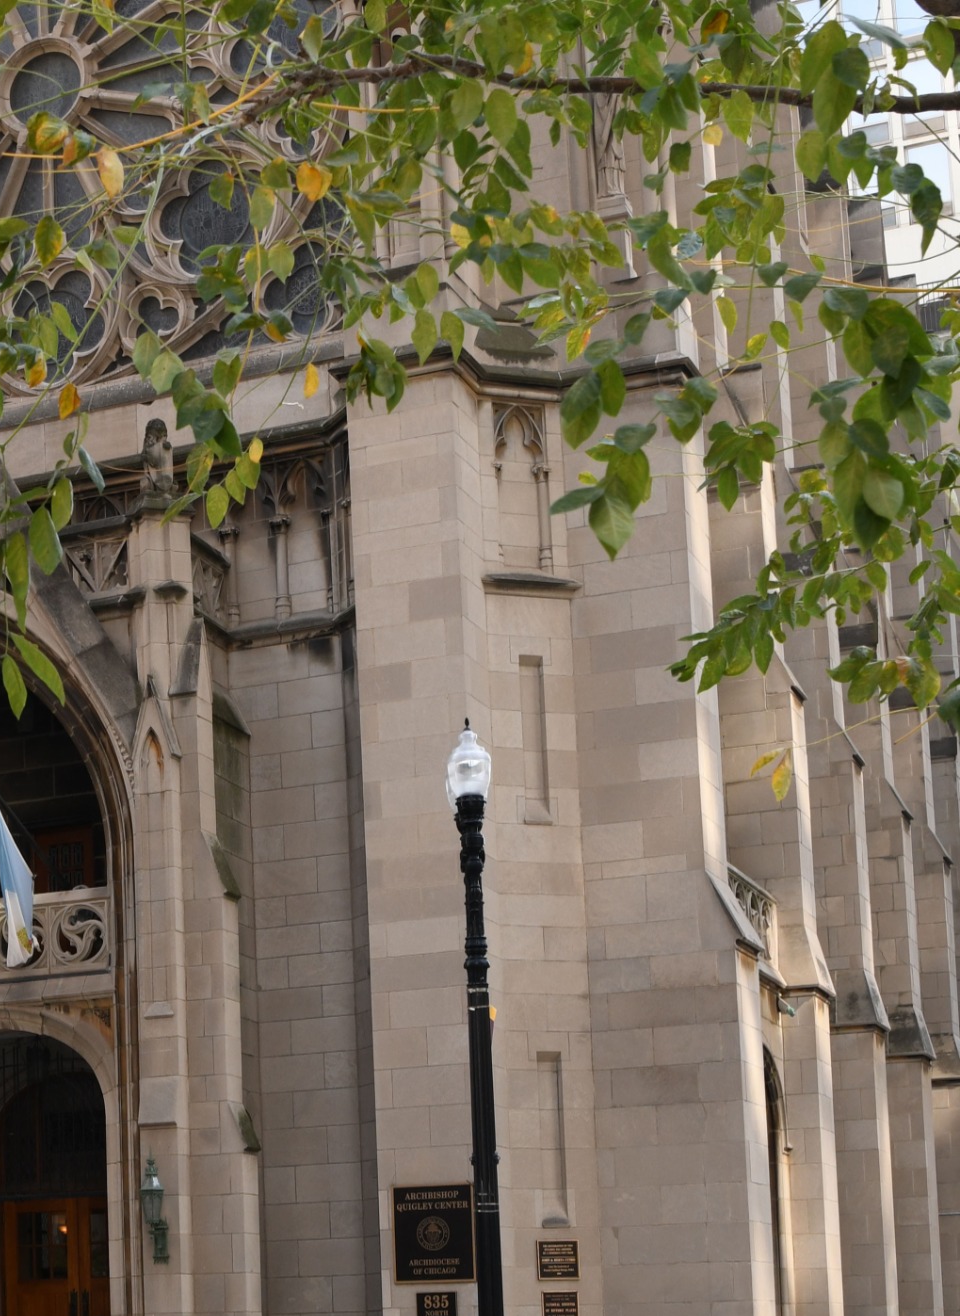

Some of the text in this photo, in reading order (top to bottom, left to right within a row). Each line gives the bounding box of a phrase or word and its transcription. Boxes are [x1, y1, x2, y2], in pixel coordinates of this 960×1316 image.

[404, 1190, 459, 1200] ARCHBISHOP
[396, 1201, 469, 1212] QUIGLEY CENTER
[409, 1258, 460, 1267] ARCHDIOCESE
[424, 1267, 457, 1275] CHICAGO
[424, 1294, 449, 1309] 835
